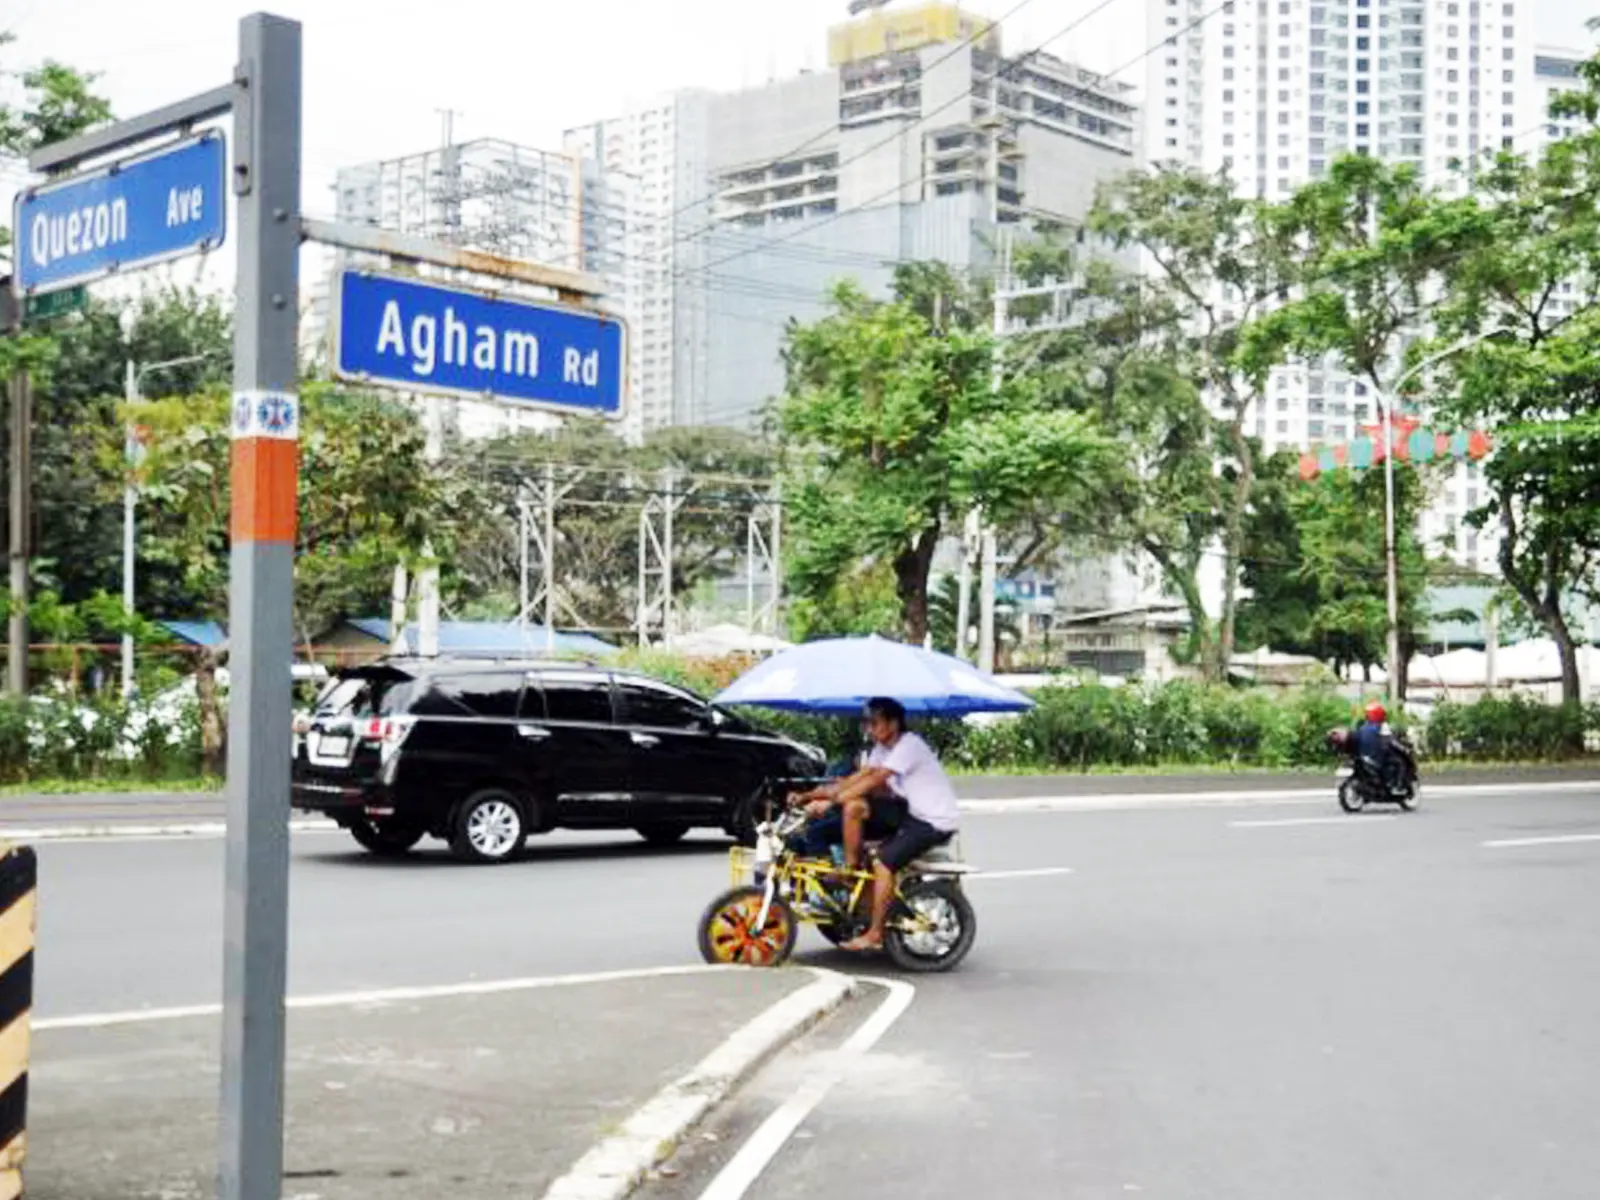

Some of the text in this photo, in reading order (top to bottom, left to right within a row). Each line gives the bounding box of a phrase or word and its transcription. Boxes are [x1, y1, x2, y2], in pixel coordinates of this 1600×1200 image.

[31, 184, 203, 267] Quezon Ave
[376, 299, 599, 386] Agham Rd
